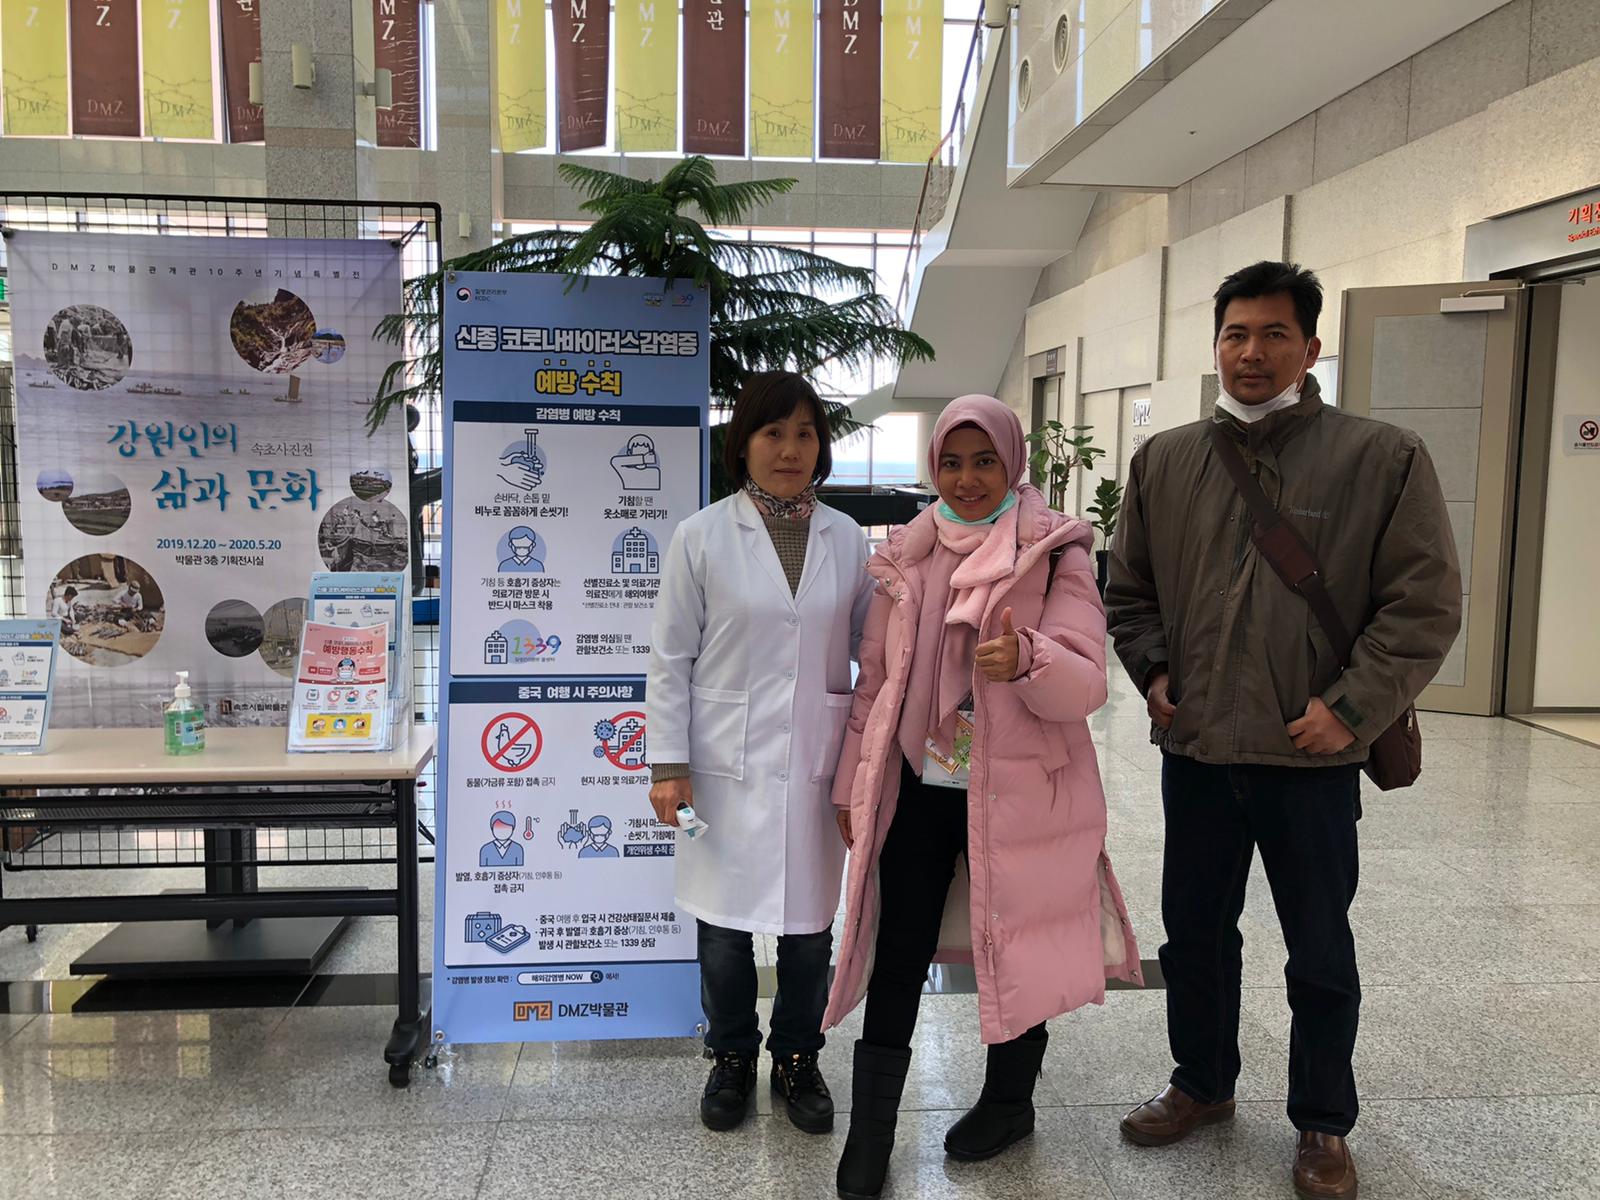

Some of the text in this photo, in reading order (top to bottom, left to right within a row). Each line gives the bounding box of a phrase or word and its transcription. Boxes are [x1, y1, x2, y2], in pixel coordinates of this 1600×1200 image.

[707, 0, 725, 31] 관
[773, 0, 791, 54] MZ
[87, 99, 124, 116] DMZ
[159, 100, 195, 117] DMZ
[629, 116, 664, 131] DMZ
[697, 118, 732, 136] DMZ
[764, 120, 800, 137] DMZ
[833, 123, 872, 140] DMZ
[455, 325, 698, 356] 신종 코로나바이러스감염증
[535, 369, 622, 396] 예방 수칙
[535, 407, 621, 422] 감염병 예방 수칙
[107, 420, 240, 459] 강원인의
[251, 442, 314, 457] 속초사진전
[150, 466, 324, 512] 삶과 문화
[494, 493, 550, 504] 손바닥, 손톱 밑
[618, 495, 653, 506] 기침할 땐
[475, 506, 568, 517] 비누로 꼼꼼하게 손씻기!
[604, 509, 667, 520] 옷소매로 가리기!
[175, 554, 265, 565] 박물관 3층 기획전시실
[481, 578, 560, 587] 기침 등 호흡기 증상자는
[583, 578, 661, 589] 선별진료소 및 의료기관
[492, 589, 549, 599] 의료기관 방문 시
[586, 589, 623, 599] 의료진에게
[488, 600, 553, 610] 반드시 마스크 착용
[576, 634, 632, 644] 감염병 의심될 땐
[512, 635, 561, 656] 1339
[576, 645, 650, 655] 관할보건소 또는 1339
[518, 686, 632, 699] 중국 여행 시 주의사항
[466, 777, 556, 787] 동물(가금류 포함) 접촉 금지
[581, 775, 649, 786] 현지 시장 및 의료기관
[628, 818, 648, 828] 기침시
[628, 830, 650, 841] 손씻기,
[627, 845, 653, 855] 개인위생
[655, 845, 668, 855] 수칙
[455, 872, 472, 882] 발열,
[474, 872, 496, 881] 호흡기
[494, 883, 524, 893] 접촉 금지
[539, 912, 675, 924] 중국 여행 후 입국 시 건강상태질문서 제출
[539, 927, 554, 937] 귀국
[556, 927, 564, 936] 후
[565, 927, 587, 936] 발열과
[589, 926, 612, 936] 호흡기
[648, 925, 670, 935] 인후통
[671, 925, 681, 935] 등)
[538, 938, 656, 949] 발생 시 관할보건소 또는 1339 상담
[451, 976, 468, 985] 감염병
[470, 976, 482, 984] 발생
[484, 976, 496, 984] 정보
[531, 974, 564, 982] 해외감염병
[516, 1002, 550, 1020] DMZ
[558, 1003, 629, 1017] DMZ박물관
